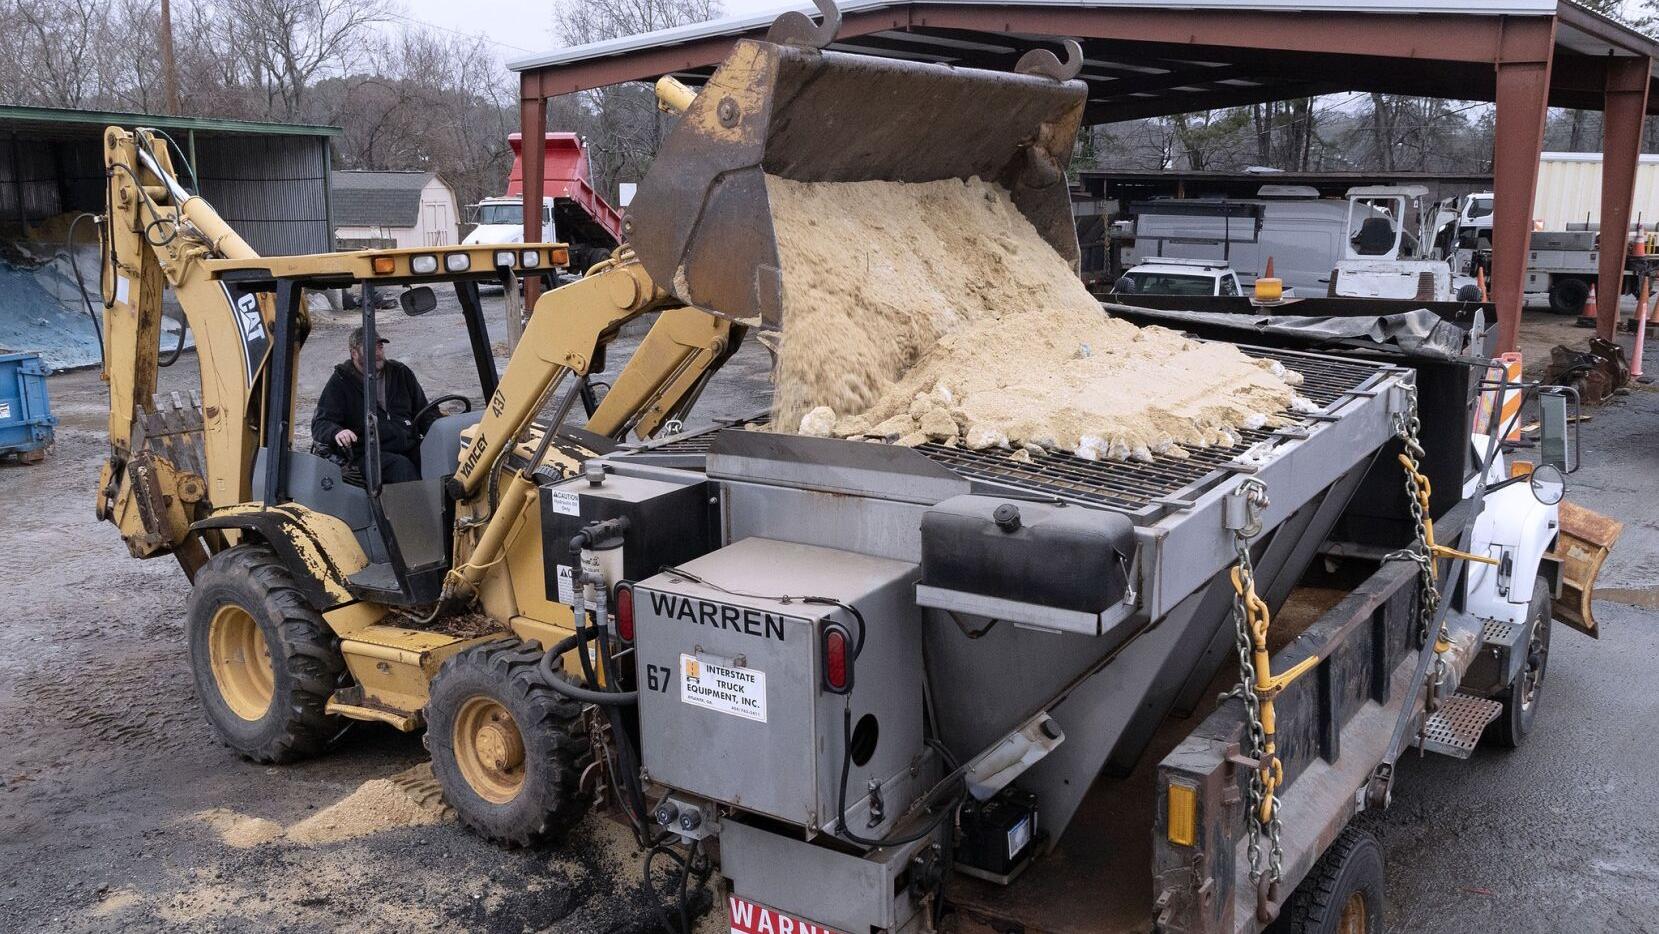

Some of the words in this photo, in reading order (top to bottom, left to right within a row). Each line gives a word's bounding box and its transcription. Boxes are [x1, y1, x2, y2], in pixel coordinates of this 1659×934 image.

[237, 292, 266, 341] CAT
[492, 388, 506, 418] 437
[460, 433, 488, 479] YANCEY
[558, 492, 578, 501] CAUTION
[650, 591, 785, 641] WARREN
[646, 664, 671, 693] 67
[706, 665, 755, 683] INTERSTATE
[716, 680, 745, 694] TRUCK
[687, 687, 739, 705] EQUIPMENT,
[741, 697, 761, 709] INC.
[729, 897, 830, 934] WAR
